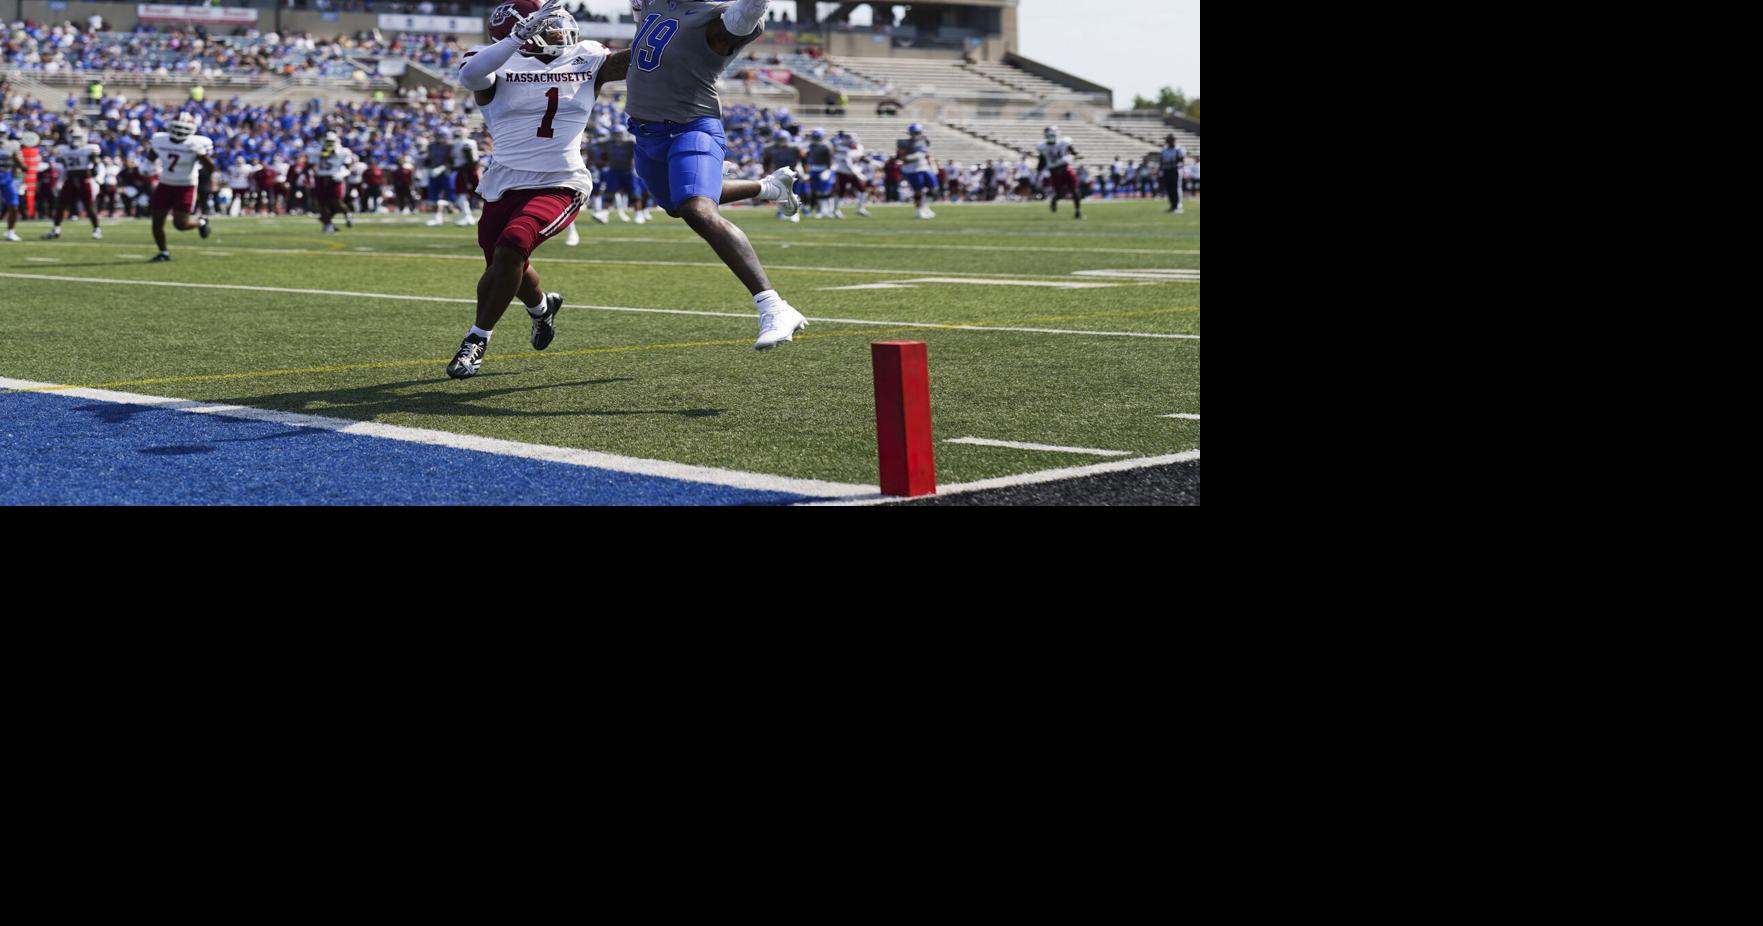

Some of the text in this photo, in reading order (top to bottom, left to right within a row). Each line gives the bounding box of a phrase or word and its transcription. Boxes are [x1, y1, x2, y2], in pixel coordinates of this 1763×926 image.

[630, 13, 679, 72] 19
[506, 71, 593, 82] MASSACHUSETTS
[537, 87, 559, 138] 1
[168, 153, 180, 172] 7
